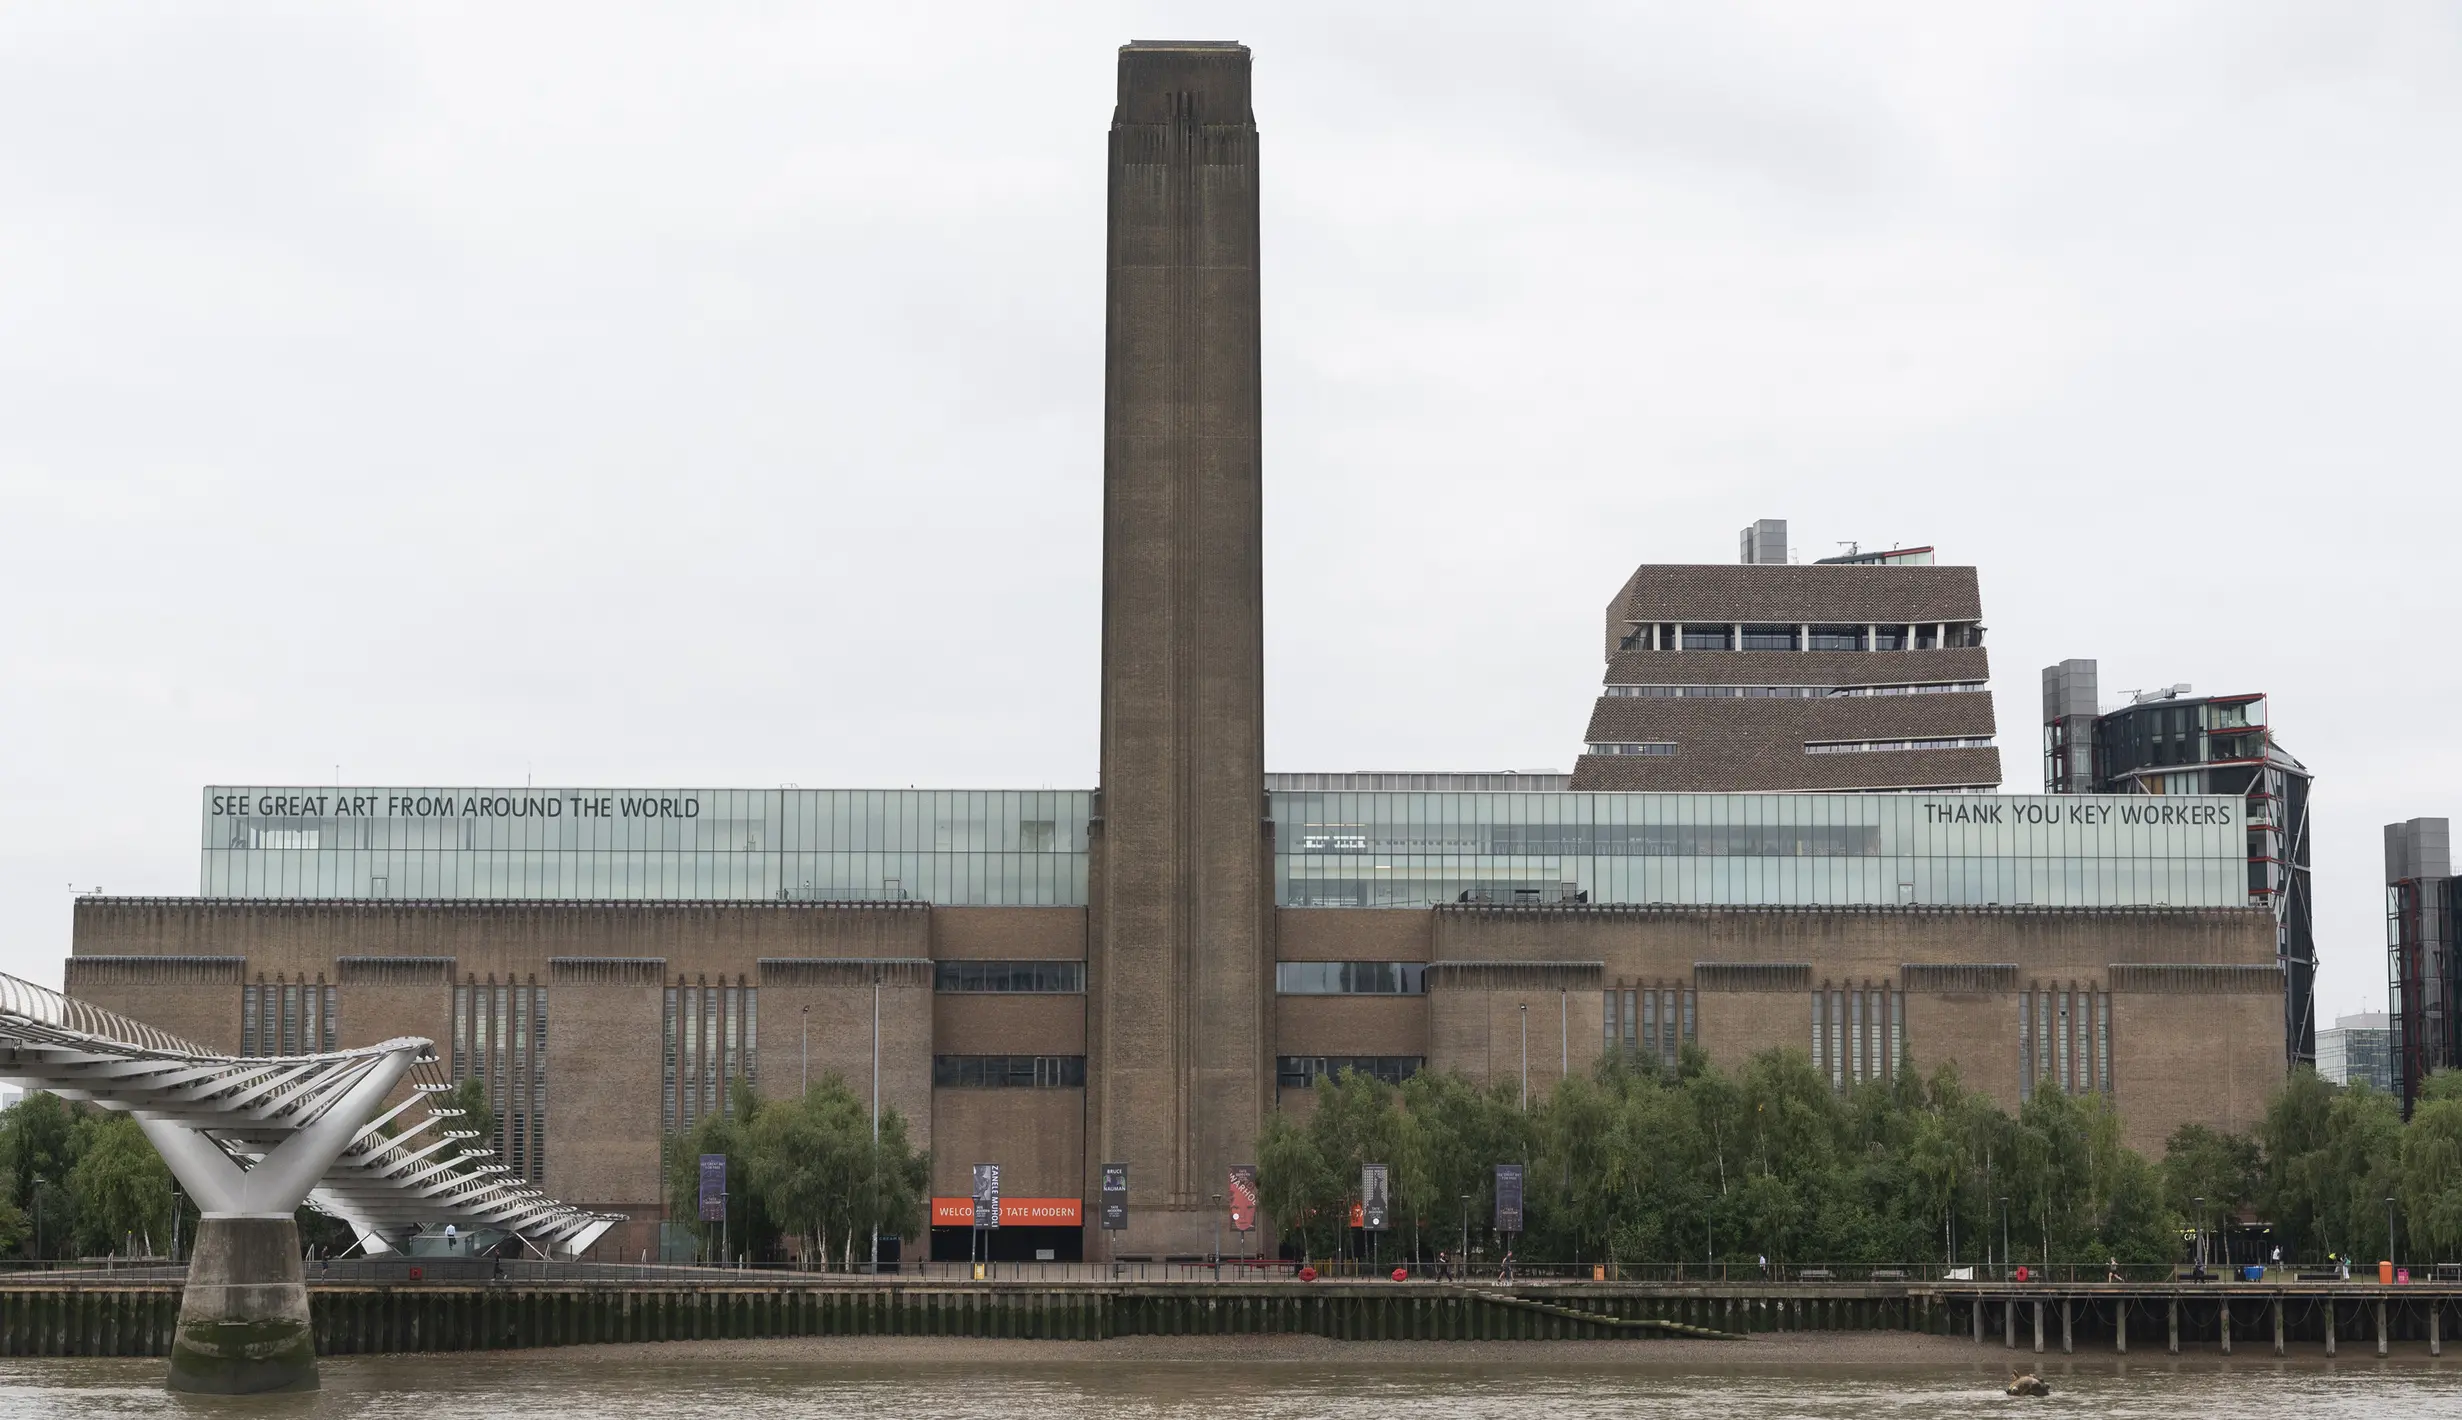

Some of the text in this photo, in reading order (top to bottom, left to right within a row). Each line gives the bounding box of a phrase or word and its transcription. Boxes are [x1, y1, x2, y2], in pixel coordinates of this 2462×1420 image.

[212, 796, 700, 818] SEE GREAT ART FROM AROUND THE WORLD
[1923, 804, 2231, 825] THANK YOU KEY WORKERS
[991, 1165, 999, 1228] ZANELE MUHOLI
[939, 1207, 974, 1217] WELCO
[1006, 1207, 1029, 1217] TATE
[1031, 1207, 1075, 1217] MODERN
